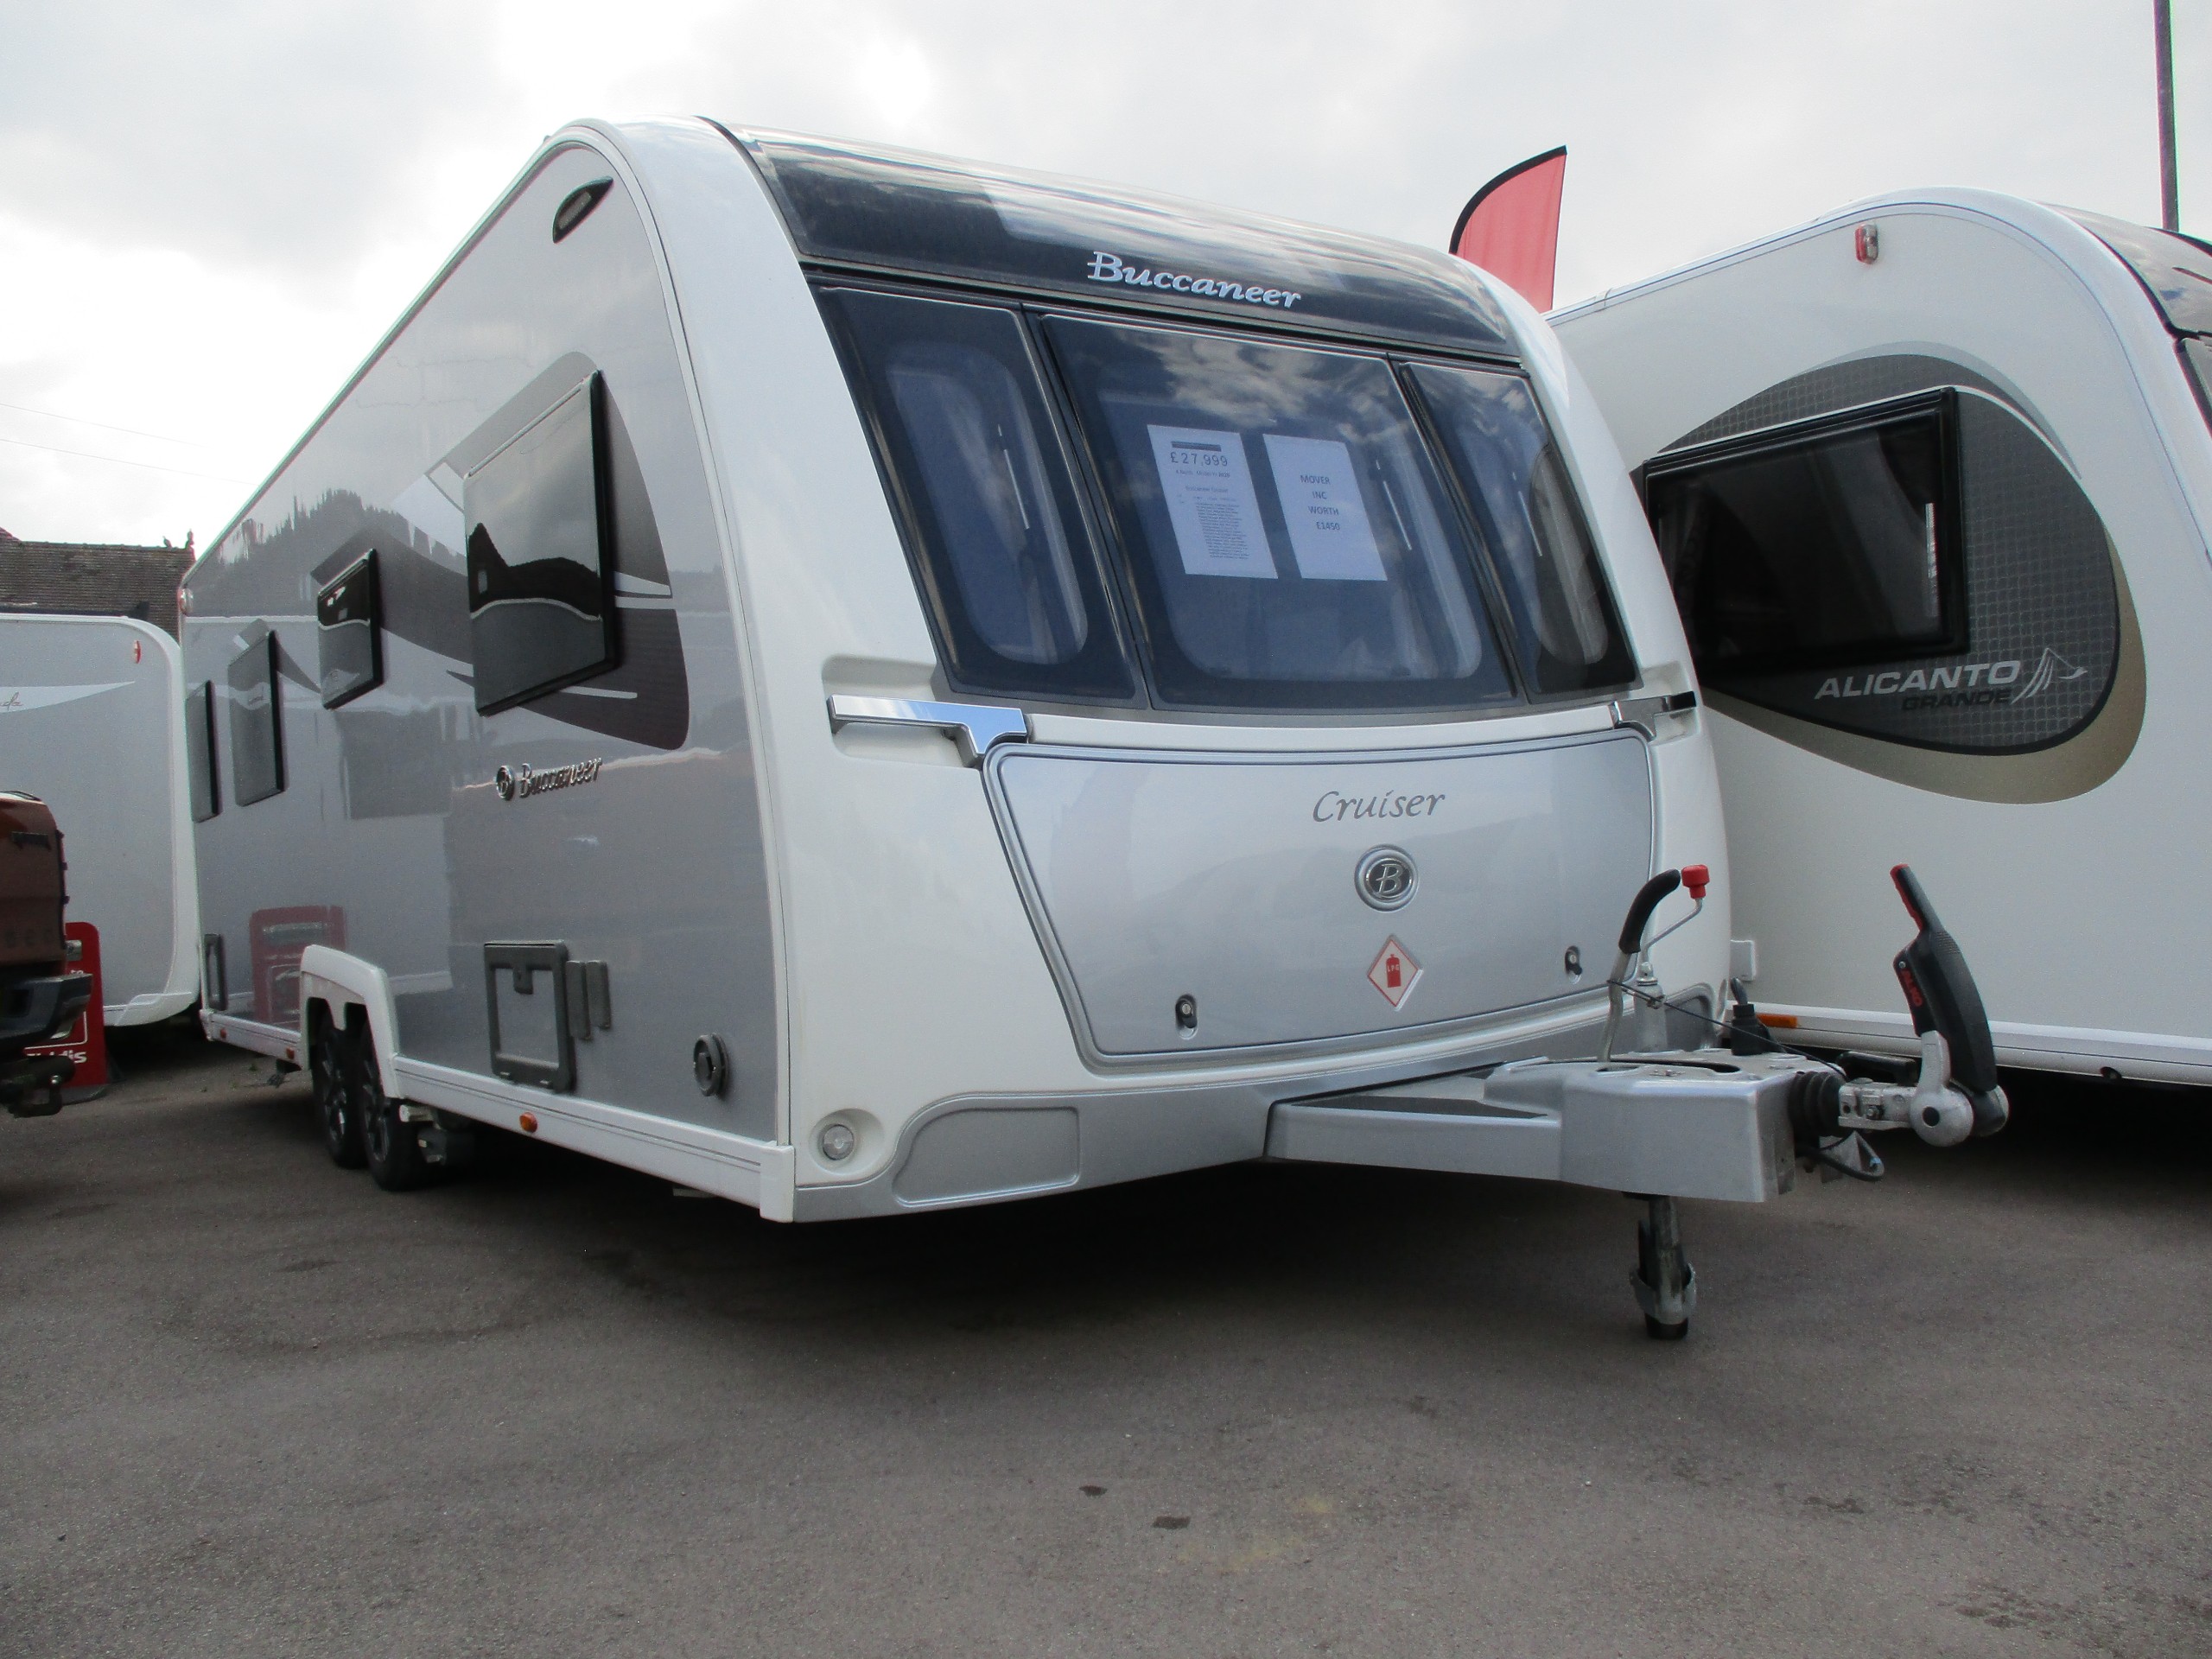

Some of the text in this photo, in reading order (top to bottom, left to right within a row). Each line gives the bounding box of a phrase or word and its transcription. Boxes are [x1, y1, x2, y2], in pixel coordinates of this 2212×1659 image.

[1087, 251, 1301, 308] Buccaneer
[1300, 474, 1331, 486] MOVER
[1312, 491, 1328, 500] INC
[1307, 505, 1339, 516] WORTH
[1814, 660, 2021, 700] ALICANTO
[1902, 689, 2012, 710] GRANDE
[1312, 789, 1446, 823] Cruiser
[1387, 963, 1400, 973] LPG
